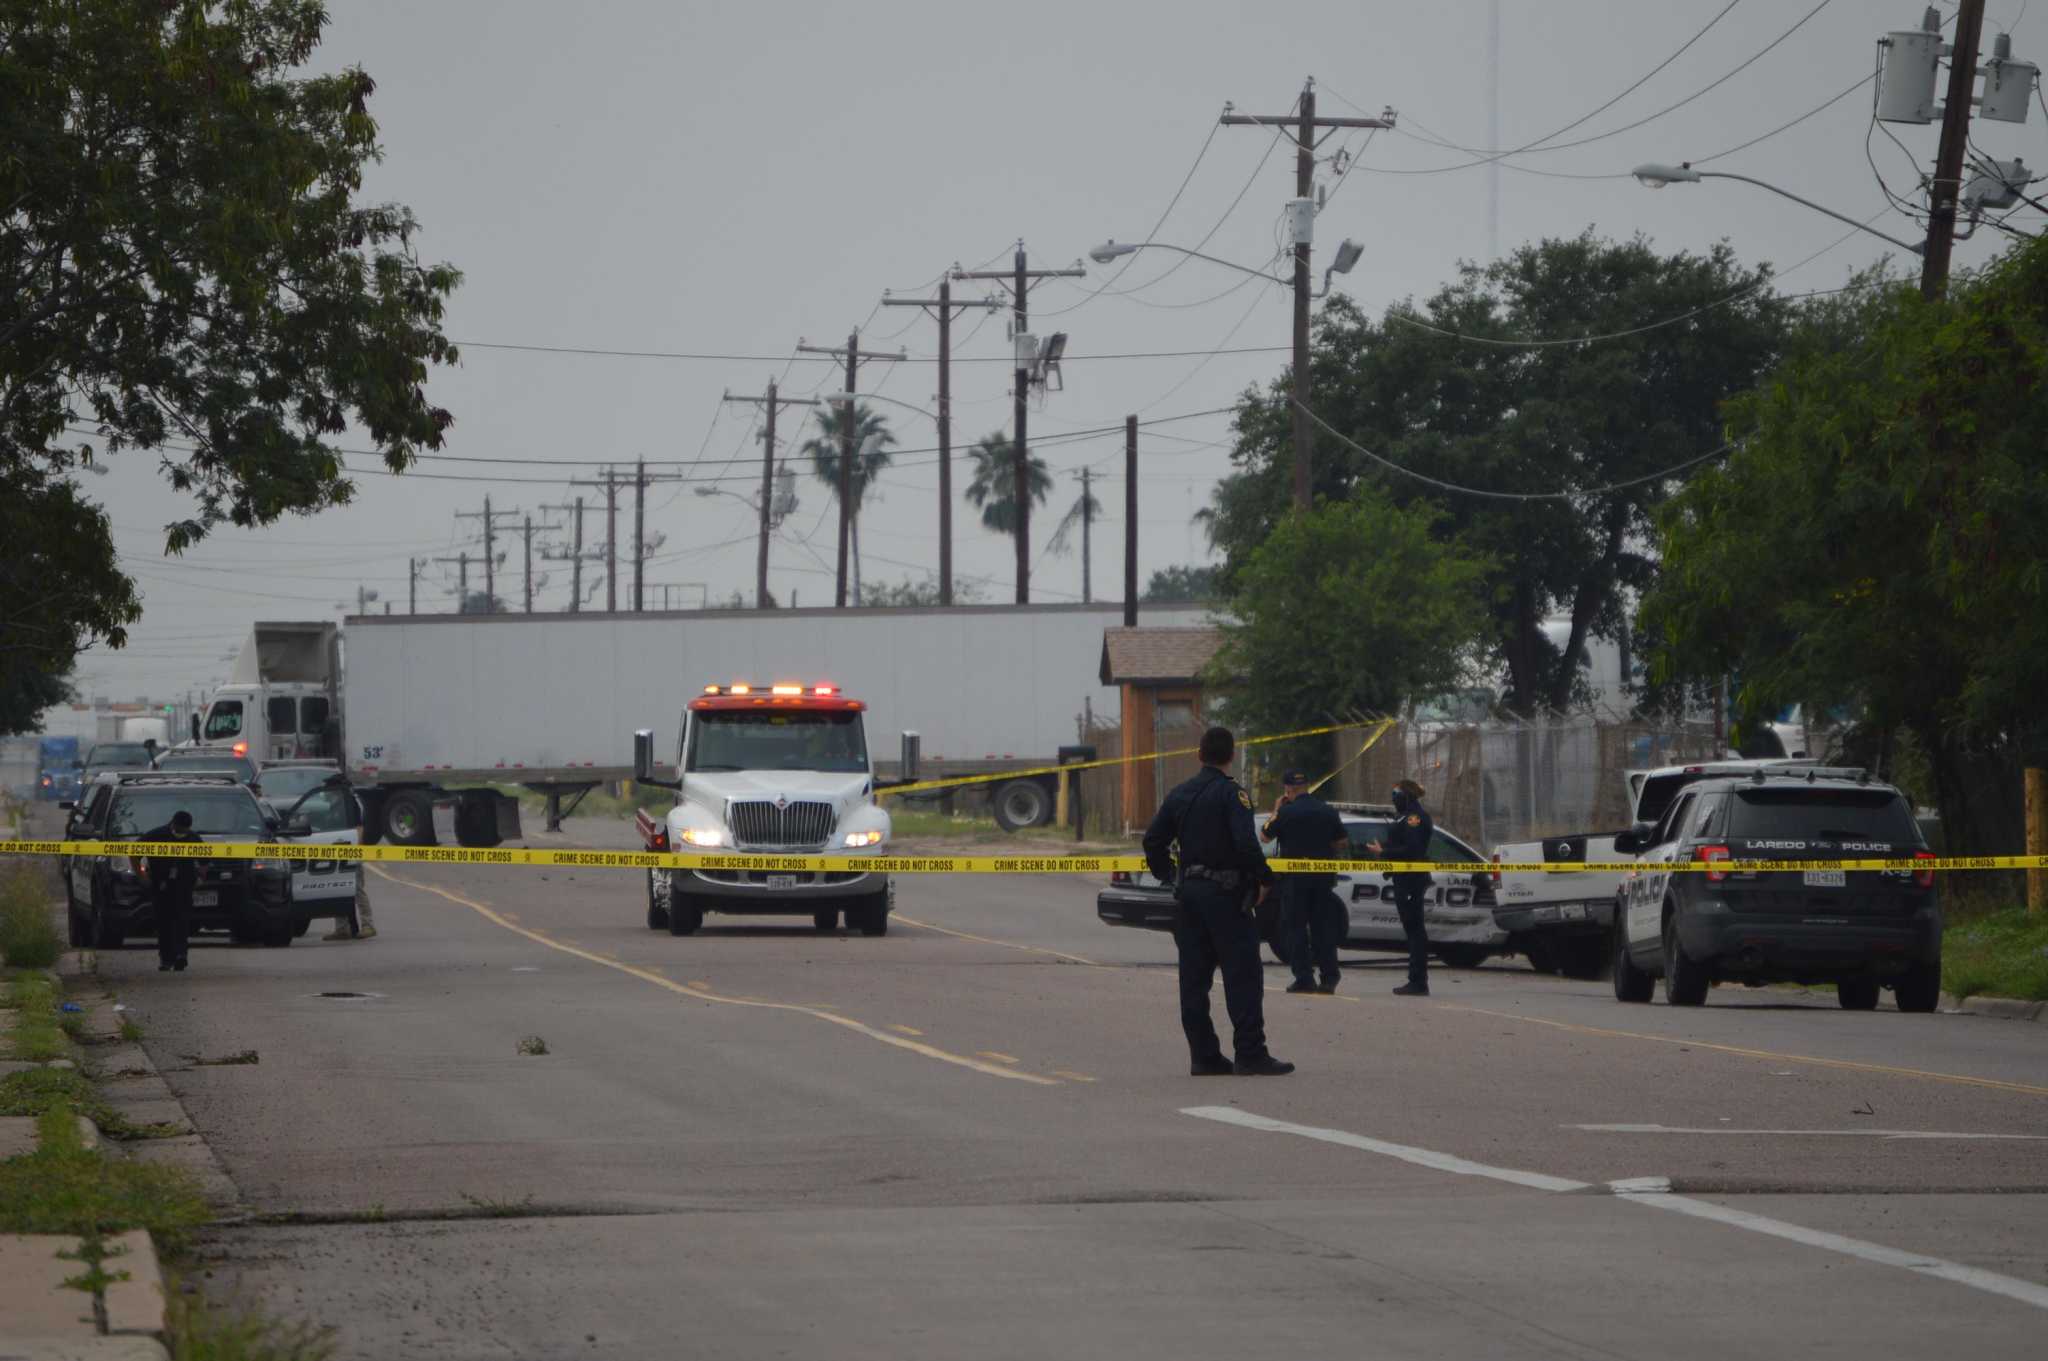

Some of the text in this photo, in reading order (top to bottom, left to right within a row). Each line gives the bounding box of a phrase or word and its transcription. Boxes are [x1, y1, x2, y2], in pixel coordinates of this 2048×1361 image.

[104, 844, 213, 856] CRIME SCENE DO NOT CROSS
[1747, 840, 1892, 851] LAREDO POLICE
[255, 846, 363, 858] CRIME SCENE DO NOT CROSS
[404, 848, 512, 862] CRIME SCENE DO NOT CROSS
[553, 853, 660, 866] CRIME SCENE DO NOT CROSS
[701, 856, 807, 869] CRIME SCENE DO NOT CROSS
[848, 859, 953, 871] CRIME SCENE DO NOT CROSS
[994, 859, 1100, 870] CRIME SCENE DO NOT CROSS
